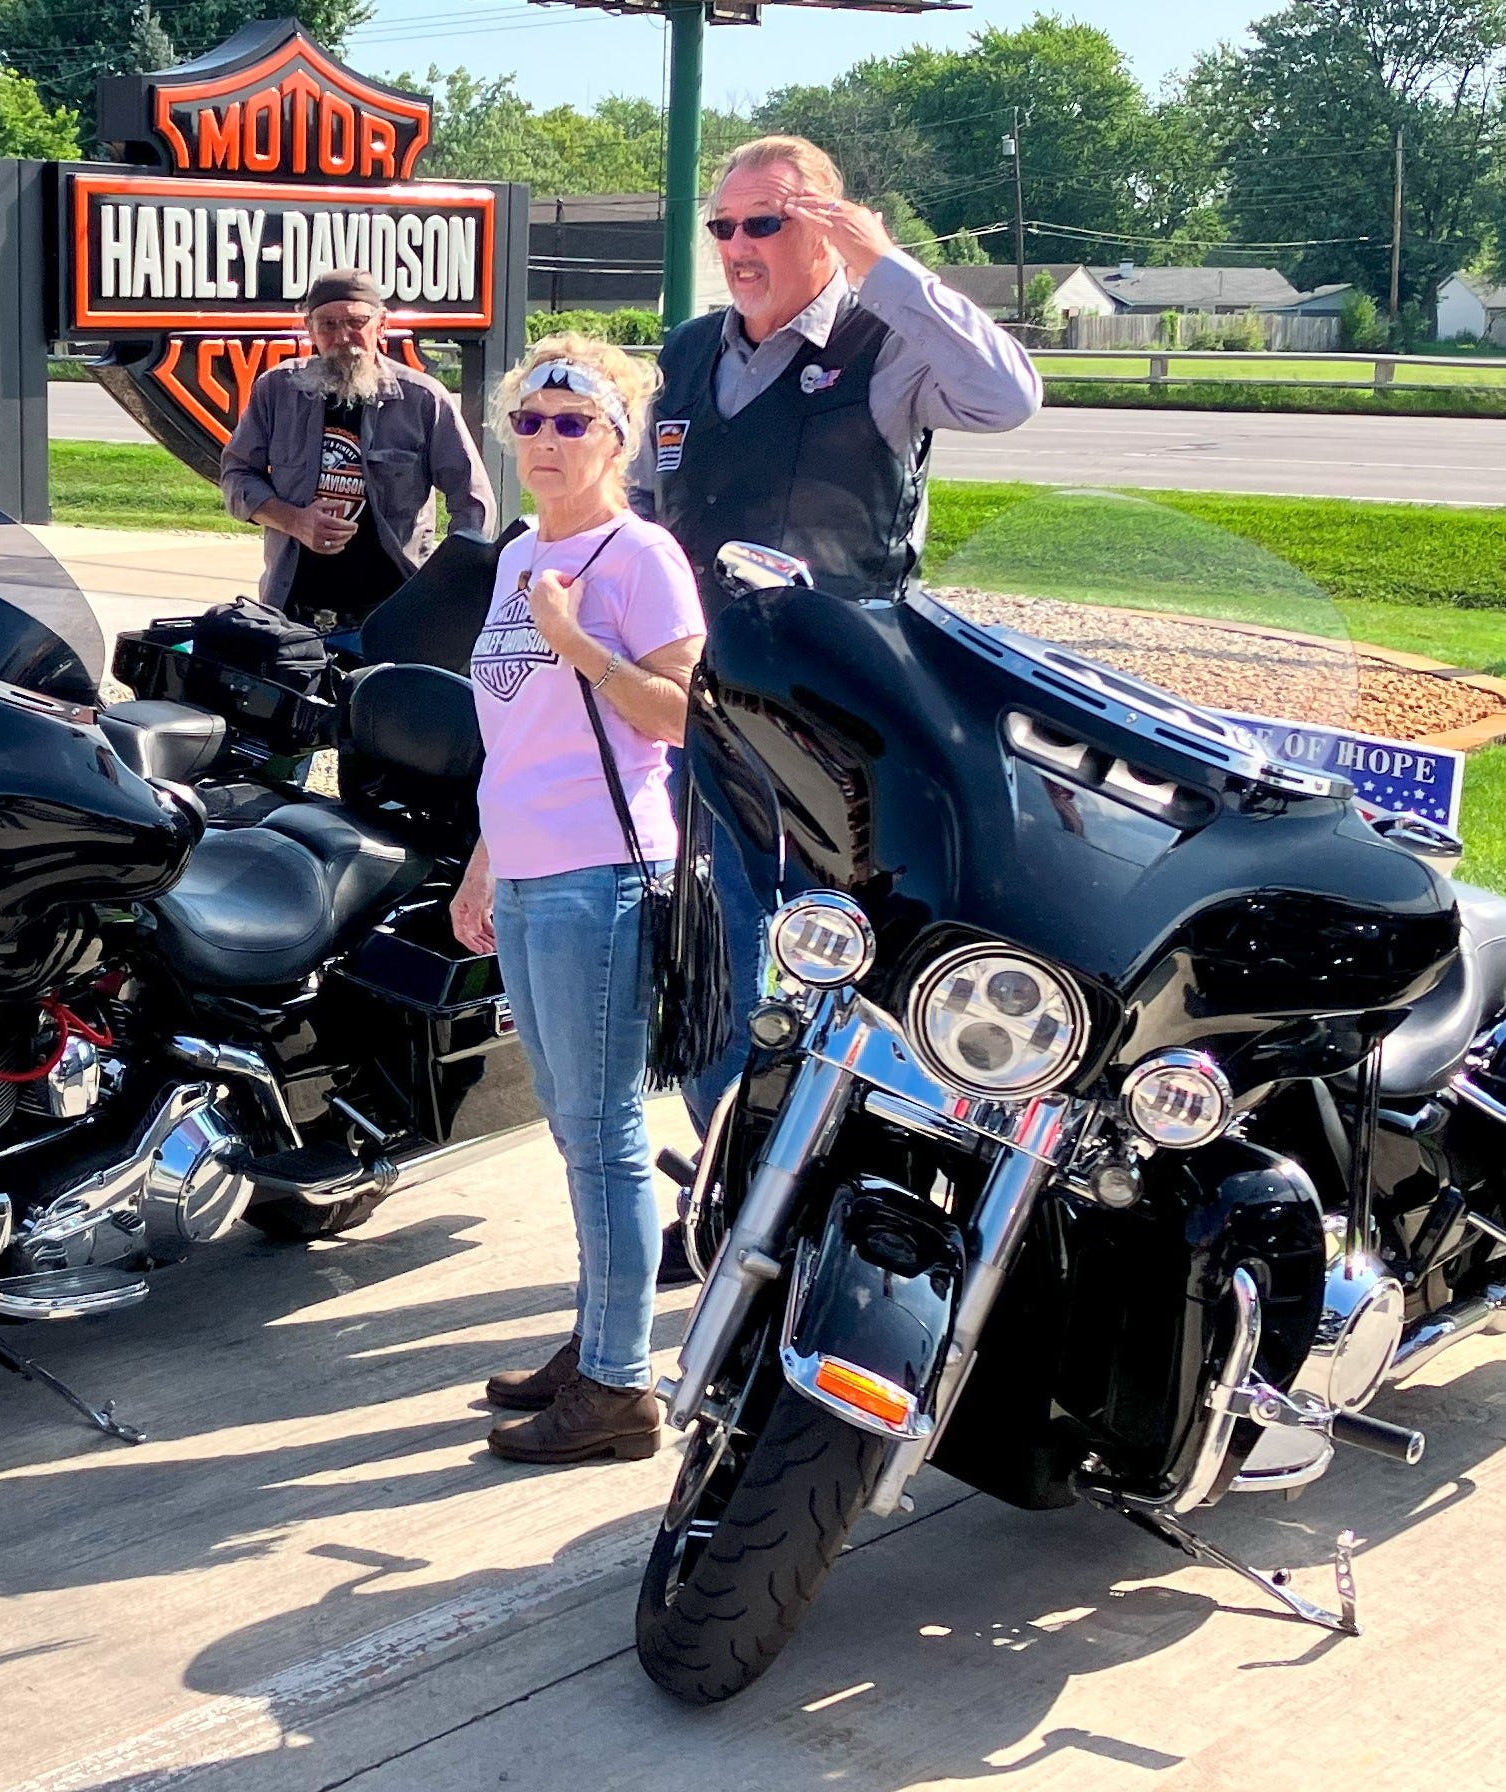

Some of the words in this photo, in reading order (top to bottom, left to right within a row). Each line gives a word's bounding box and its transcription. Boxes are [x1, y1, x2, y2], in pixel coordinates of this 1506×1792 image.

[198, 68, 396, 179] MOTOR
[100, 204, 476, 302] HARLEY-DAVIDSON
[319, 473, 365, 495] DAVIDSON
[1284, 732, 1327, 762] OF
[1335, 740, 1437, 784] HOPE
